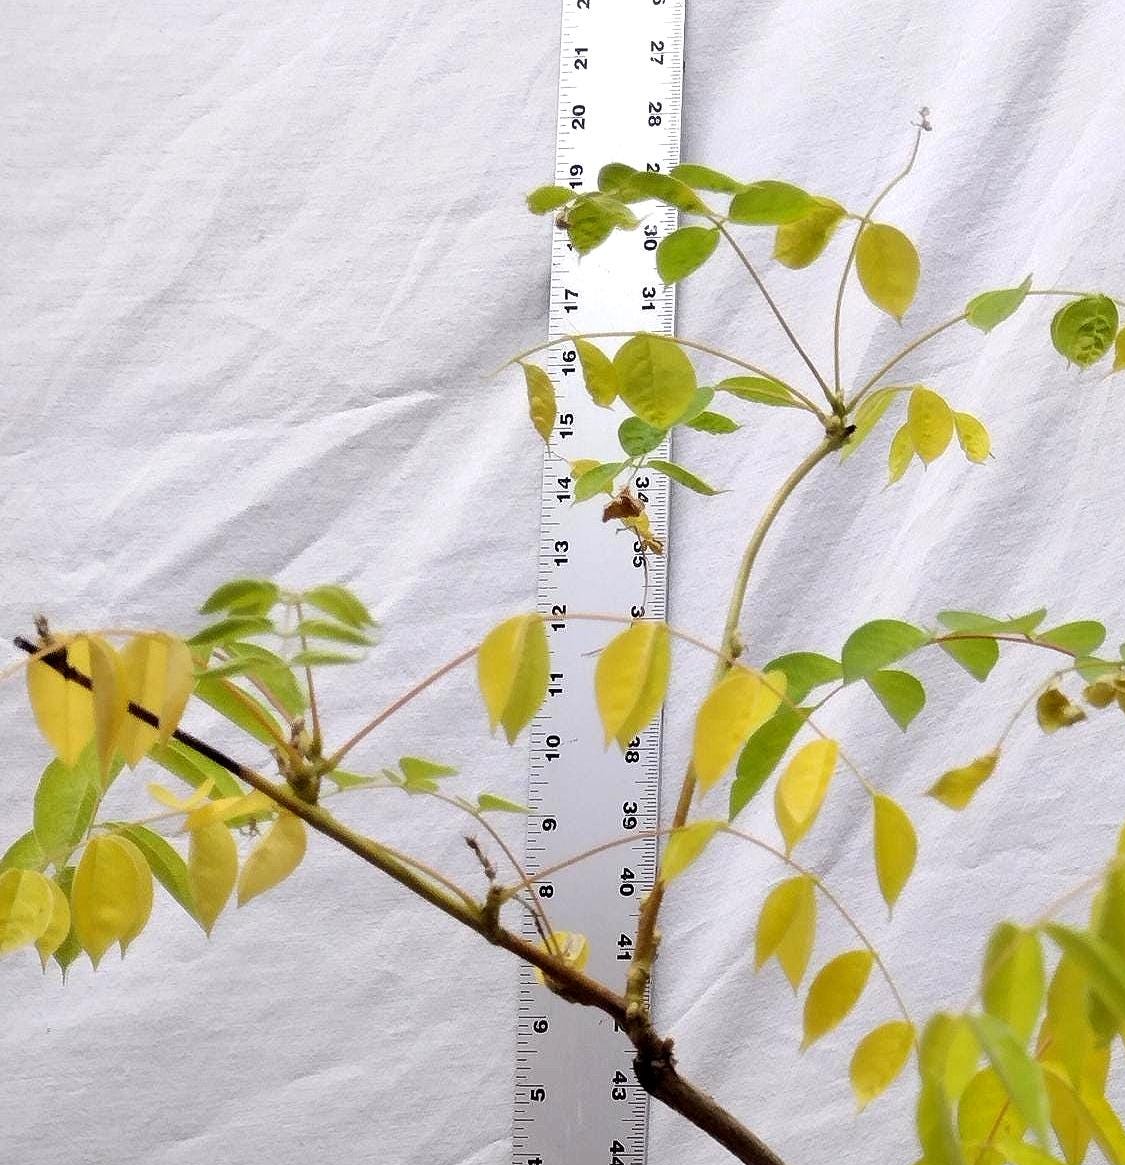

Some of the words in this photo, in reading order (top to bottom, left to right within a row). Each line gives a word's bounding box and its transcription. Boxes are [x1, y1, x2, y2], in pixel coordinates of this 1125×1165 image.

[574, 48, 588, 70] 21
[650, 40, 664, 65] 27
[572, 104, 586, 130] 20
[648, 102, 662, 127] 28
[569, 164, 584, 189] 19
[644, 225, 658, 251] 30
[564, 289, 579, 313] 17
[642, 287, 656, 310] 31
[562, 350, 576, 376] 16
[560, 413, 574, 439] 15
[557, 477, 571, 503] 14
[636, 476, 650, 503] 34
[554, 540, 569, 566] 13
[551, 605, 567, 631] 12
[549, 674, 563, 696] 11
[545, 735, 561, 761] 10
[542, 818, 557, 831] 9
[623, 802, 637, 830] 39
[539, 885, 554, 898] 8
[620, 868, 635, 896] 40
[617, 934, 632, 960] 41
[533, 1019, 548, 1033] 6
[531, 1088, 545, 1102] 5
[612, 1071, 627, 1100] 43
